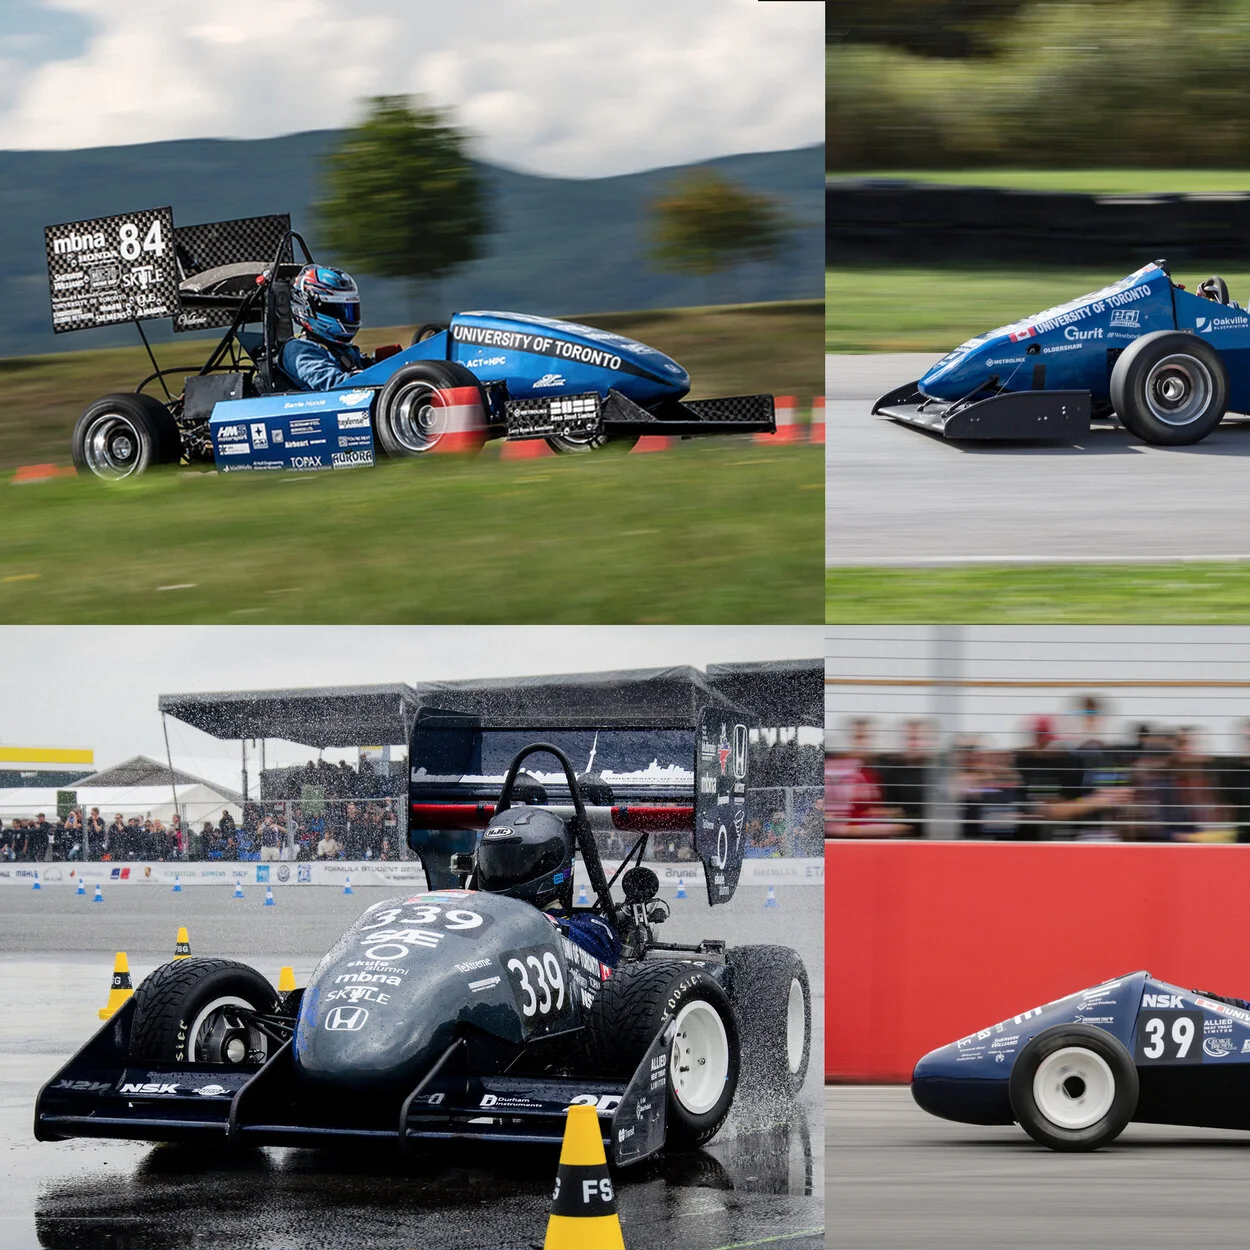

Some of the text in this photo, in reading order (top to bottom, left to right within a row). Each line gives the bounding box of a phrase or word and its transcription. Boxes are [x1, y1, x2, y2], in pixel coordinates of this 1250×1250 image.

[53, 232, 105, 254] mbna
[119, 220, 166, 261] 84
[1035, 306, 1092, 335] UNIVERSITY
[1092, 300, 1106, 314] OF
[1106, 284, 1152, 309] TORONTO
[1213, 317, 1248, 326] Oakville
[1064, 326, 1104, 341] Gurit
[453, 326, 622, 371] UNIVERSITY OF TORONTO
[1043, 343, 1083, 354] OLDERSHAW
[993, 357, 1026, 365] METROLINX
[290, 455, 322, 468] TOPAX
[333, 451, 373, 464] AURORA
[360, 865, 400, 874] STUDENT
[665, 867, 698, 878] Brunel
[360, 905, 484, 930] 339
[361, 929, 445, 949] SAE
[365, 964, 410, 976] alumni
[455, 957, 492, 973] TeXtreme
[335, 971, 402, 987] mbna
[507, 951, 565, 1018] 339
[1142, 994, 1184, 1009] NSK
[1203, 1018, 1233, 1026] ALLIED
[1143, 1016, 1195, 1059] 39
[650, 1053, 667, 1072] ALLIED
[119, 1084, 181, 1094] NSK
[582, 1178, 617, 1203] FS
